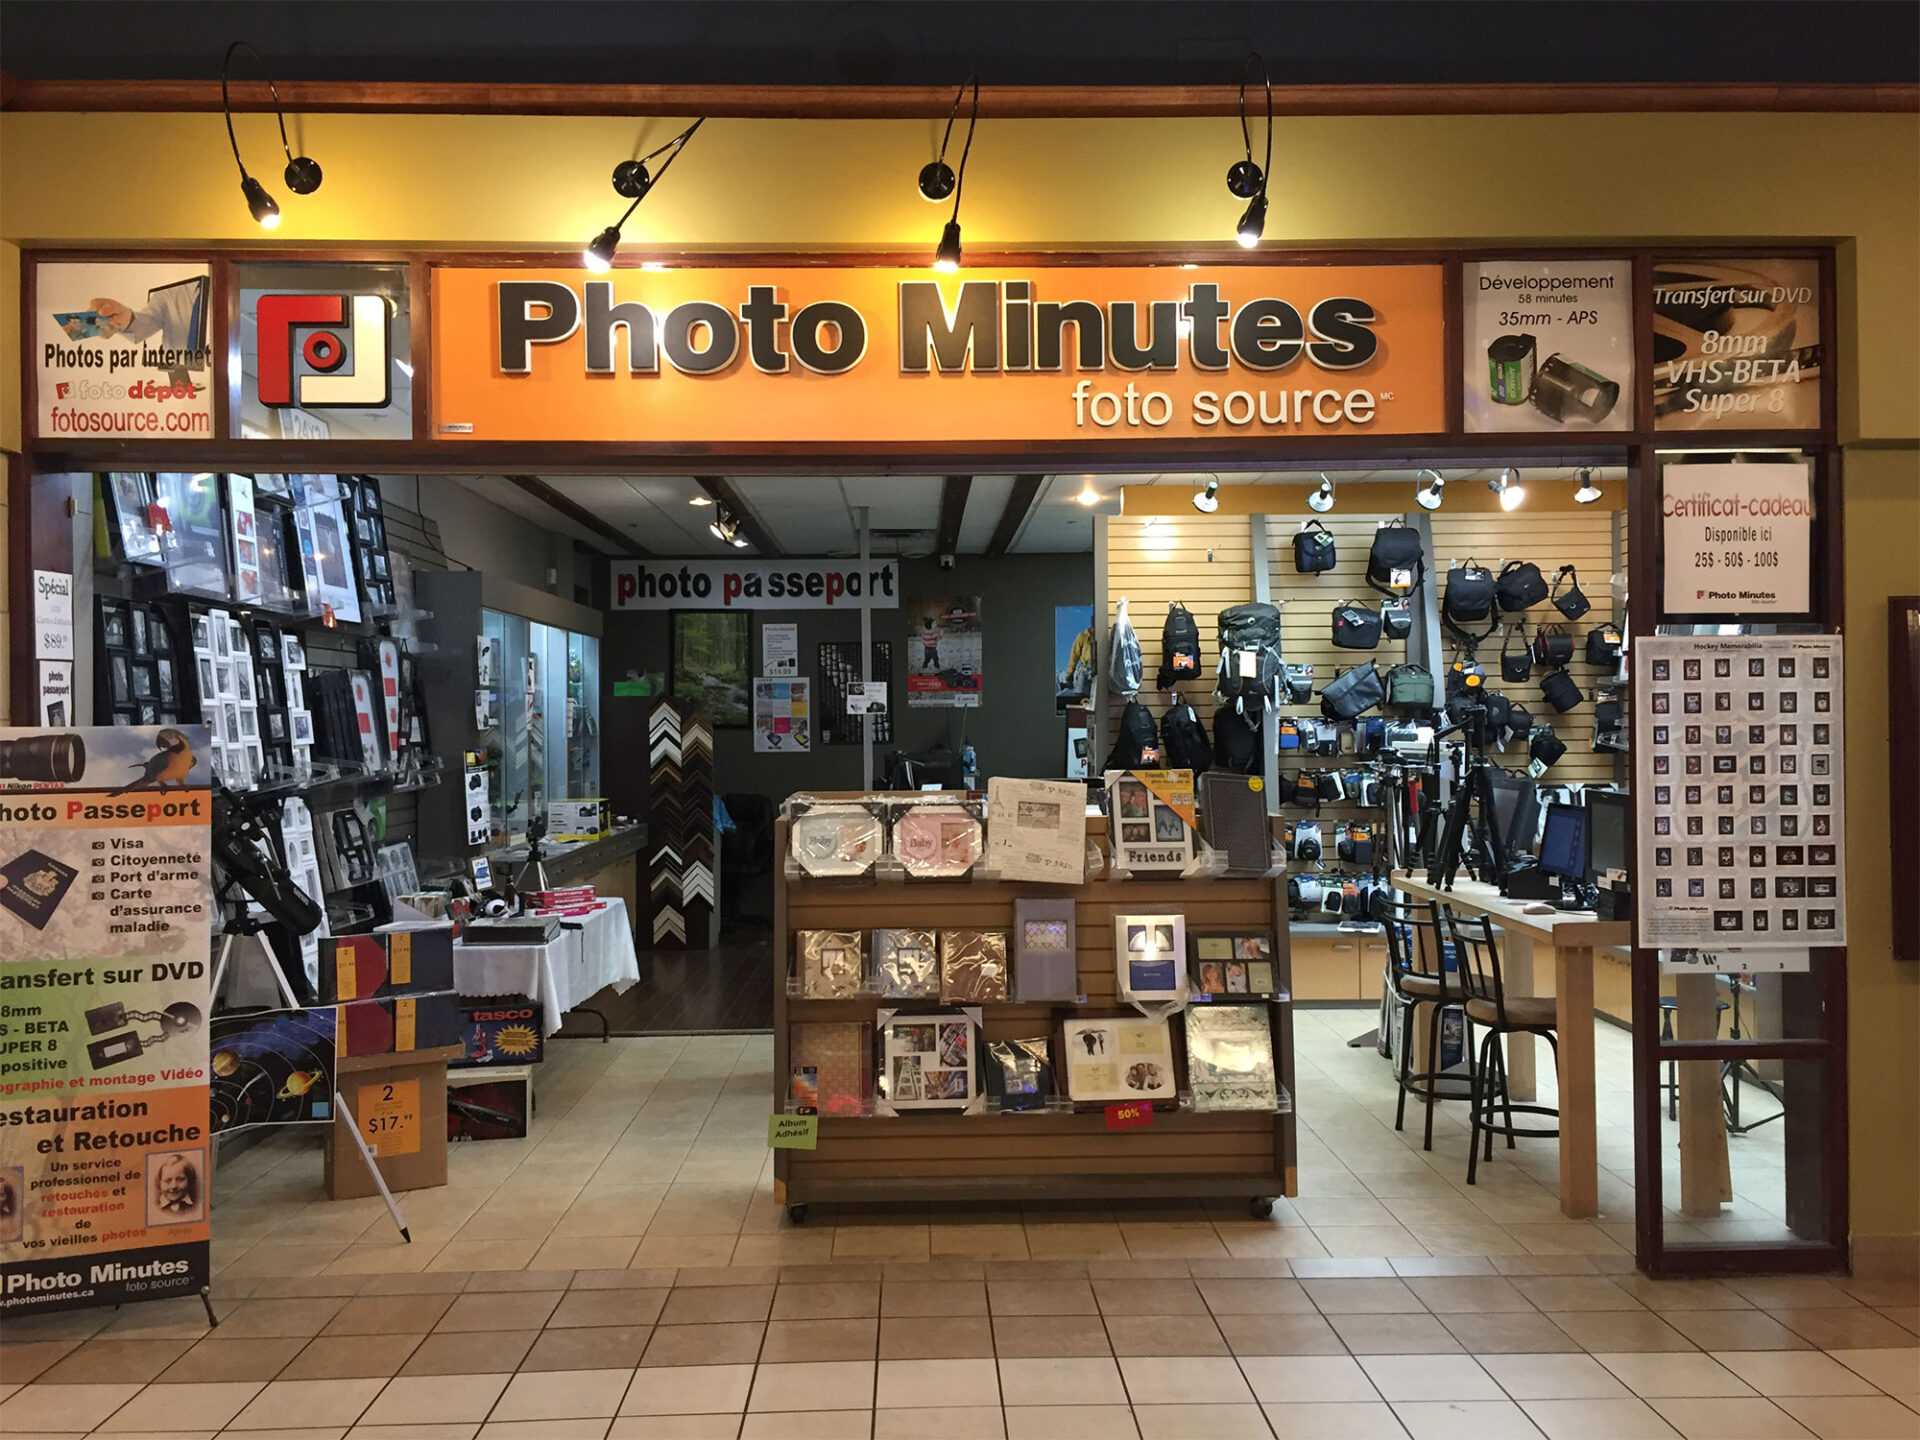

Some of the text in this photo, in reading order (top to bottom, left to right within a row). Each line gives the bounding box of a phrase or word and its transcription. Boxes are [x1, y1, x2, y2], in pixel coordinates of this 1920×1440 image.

[1479, 275, 1615, 292] Développement
[1518, 293, 1578, 304] 58 minutes
[1653, 286, 1812, 309] Transfert sur DVD
[1499, 311, 1551, 326] 35mm
[1567, 310, 1598, 326] APS
[497, 279, 1379, 376] Photo Minutes
[1701, 330, 1768, 355] 8mm
[45, 341, 211, 373] Photos par internet
[1667, 359, 1801, 385] VHS-BETA
[80, 380, 197, 403] foto dépôt
[1072, 380, 1174, 428] foto
[1192, 383, 1375, 426] source
[1683, 388, 1785, 421] Super 8
[51, 406, 210, 432] fotosource.com
[1662, 492, 1814, 518] Certificat-cadeau
[1705, 526, 1772, 544] Disponible ici
[1695, 552, 1714, 568] 25$
[1725, 552, 1743, 568] 50$
[1754, 551, 1779, 568] 100$
[38, 575, 69, 600] Spécial
[618, 564, 894, 605] photo passeport
[1708, 590, 1776, 599] Photo Minutes
[1694, 641, 1763, 651] Hockey Memorabilia
[48, 671, 63, 682] photo
[43, 684, 69, 696] passeport
[0, 799, 200, 822] hoto Passeport
[110, 838, 144, 850] Visa
[110, 852, 201, 868] Citoyenneté
[1129, 850, 1182, 863] Friends
[110, 870, 199, 883] Port d'arme
[110, 889, 152, 900] Carte
[110, 903, 202, 917] d'assurance
[110, 921, 170, 934] maladie
[0, 961, 204, 990] ansfert sur DVD
[1, 1005, 41, 1017] 8mm
[472, 1009, 533, 1021] tasco
[25, 1020, 69, 1034] BETA
[48, 1039, 57, 1051] 8
[1, 1058, 68, 1075] positive
[69, 1077, 84, 1087] et
[90, 1072, 155, 1086] montage
[161, 1068, 203, 1081] Vidéo
[383, 1085, 393, 1101] 2
[1117, 1108, 1139, 1119] 50%
[37, 1124, 201, 1154] et Retouche
[51, 1158, 122, 1172] Un service
[30, 1171, 141, 1190] professionnel de
[40, 1186, 126, 1203] retouches et
[42, 1201, 125, 1218] restauration
[75, 1219, 92, 1229] de
[23, 1227, 147, 1249] vos vieilles photos
[7, 1259, 189, 1294] Photo Minutes
[126, 1276, 190, 1292] foto source
